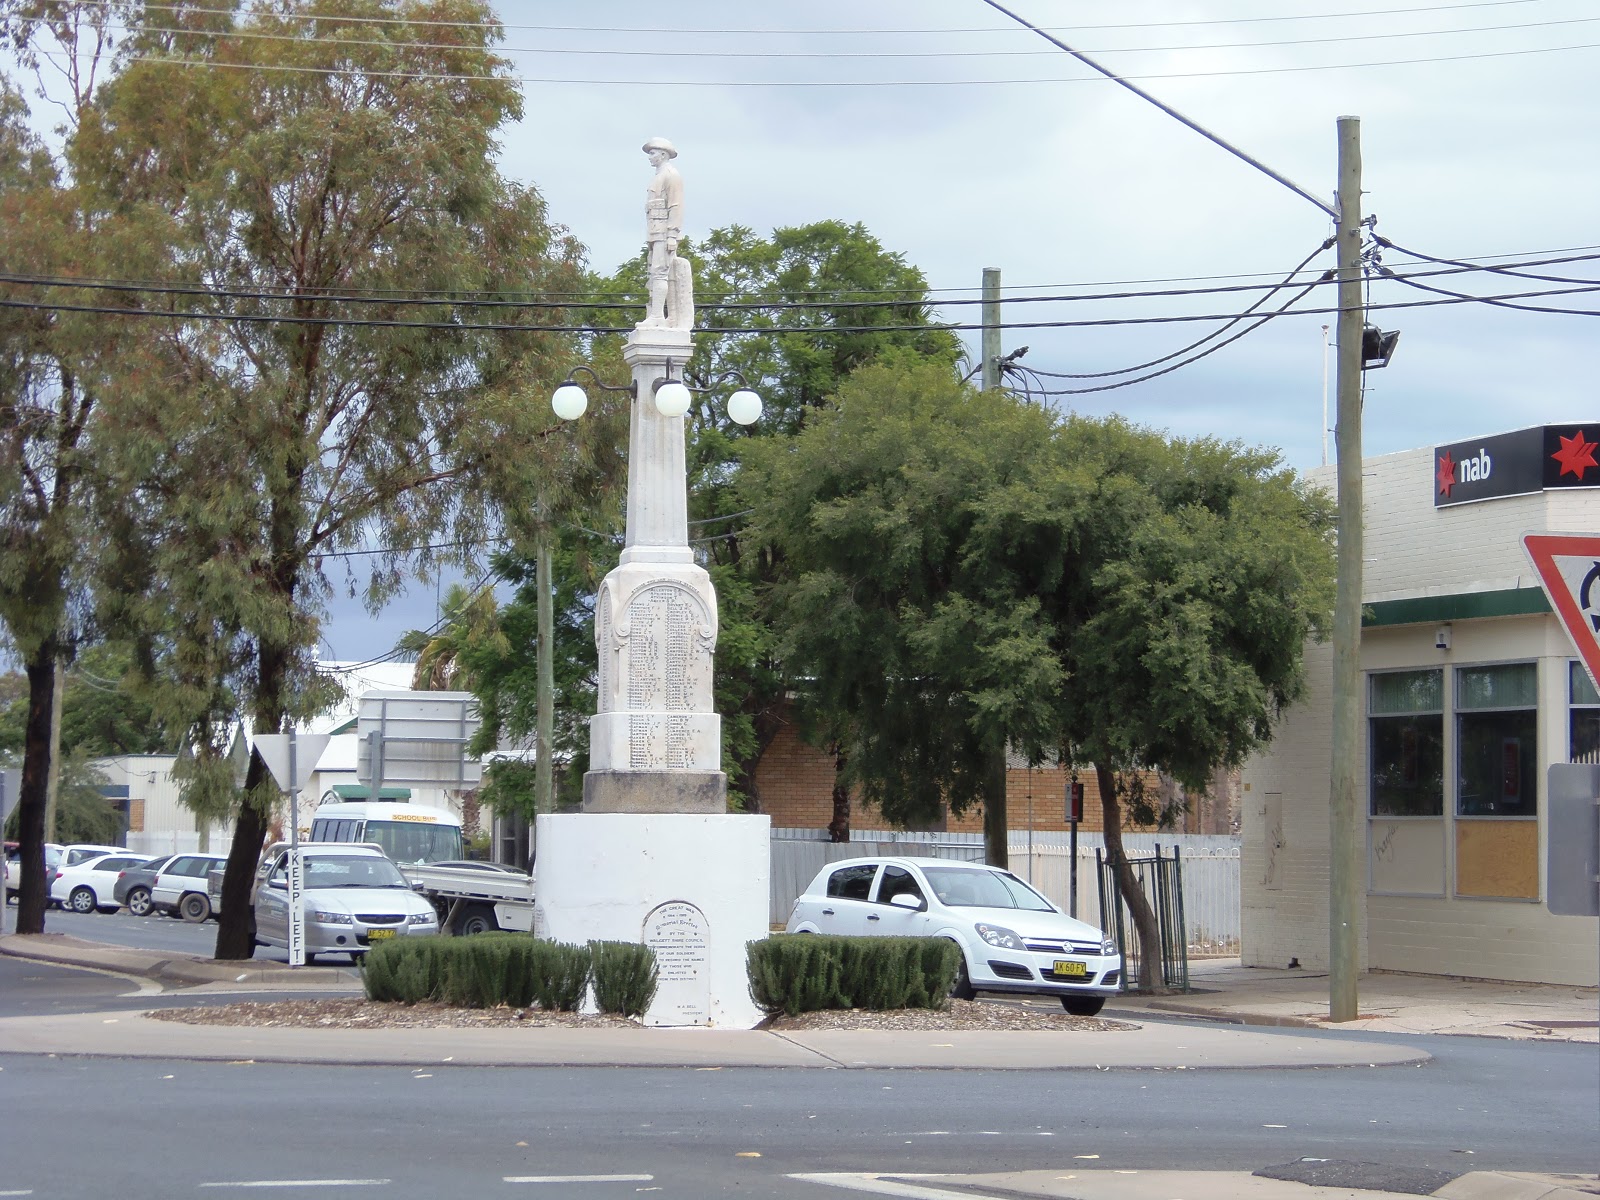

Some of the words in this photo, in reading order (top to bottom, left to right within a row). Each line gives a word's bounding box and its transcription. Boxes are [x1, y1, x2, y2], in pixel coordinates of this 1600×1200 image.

[1460, 448, 1491, 483] nab
[291, 854, 300, 903] KEEP
[293, 912, 301, 960] LEFT
[1055, 962, 1064, 971] AK
[1065, 963, 1075, 972] 60
[1076, 963, 1085, 973] FX
